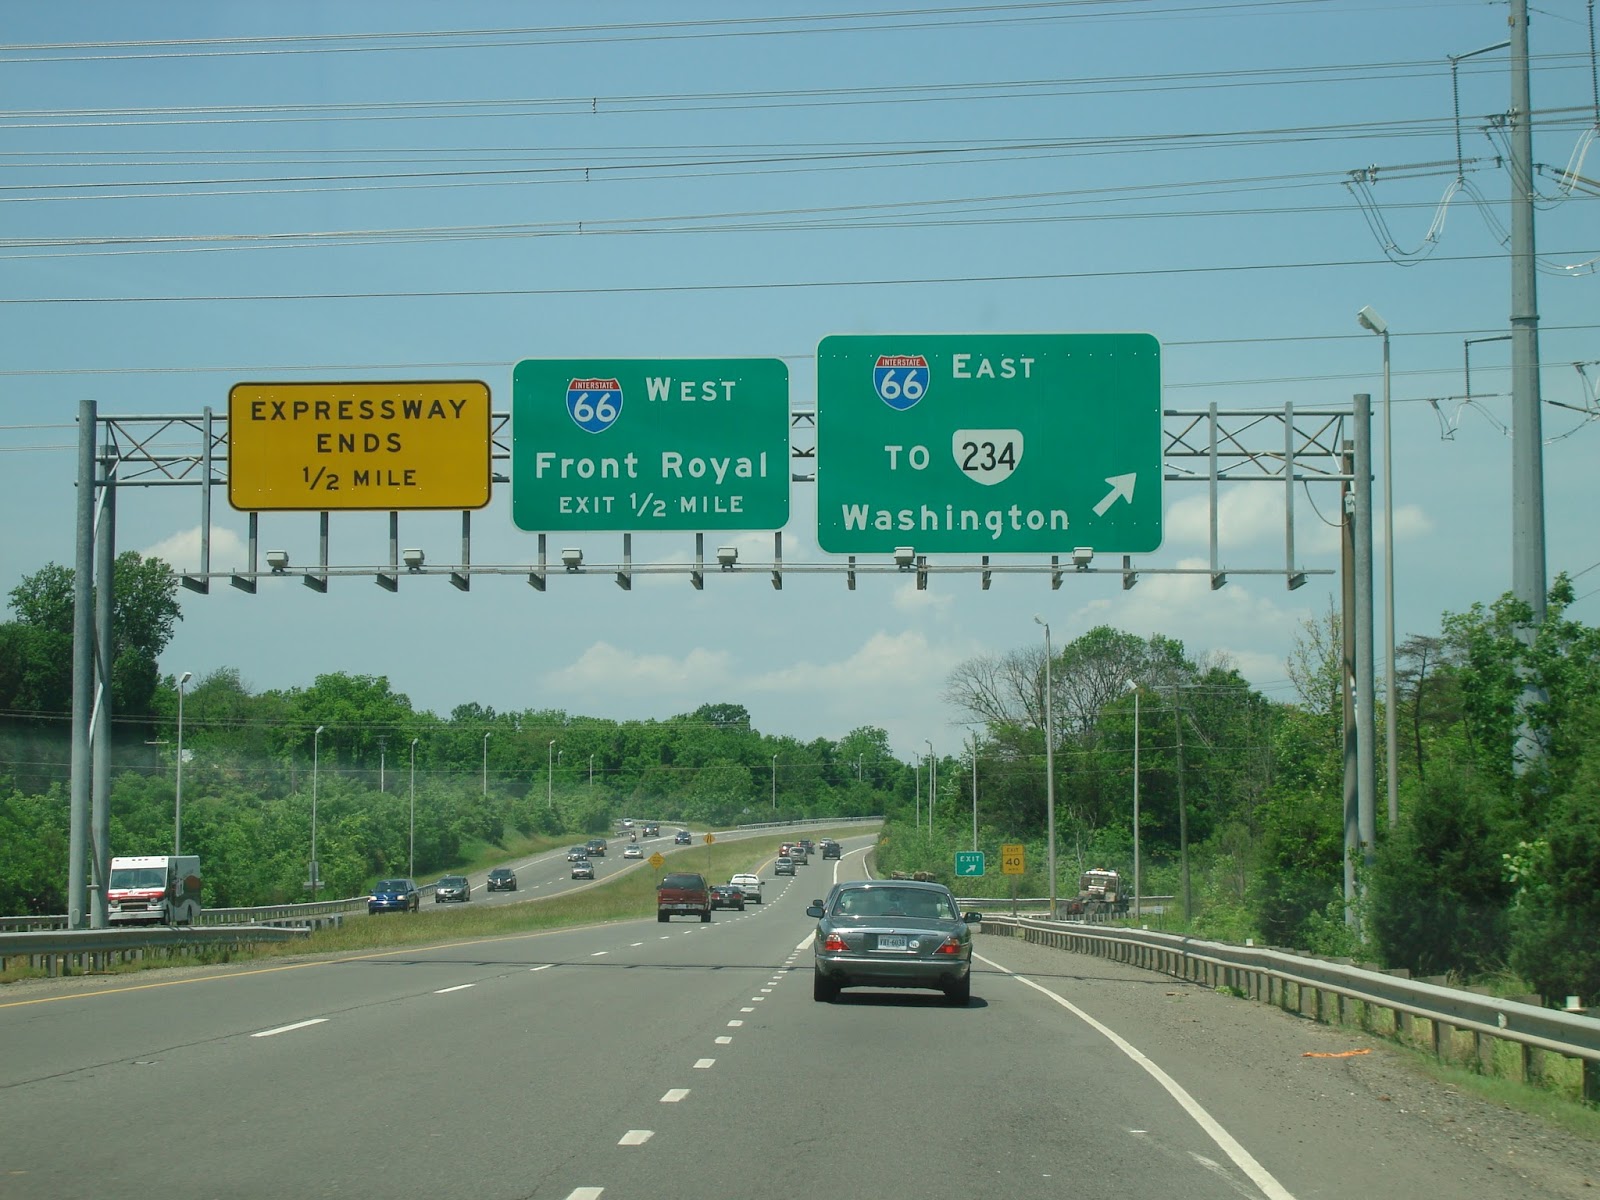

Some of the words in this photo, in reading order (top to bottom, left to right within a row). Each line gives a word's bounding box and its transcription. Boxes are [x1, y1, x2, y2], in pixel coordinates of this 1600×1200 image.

[882, 358, 920, 367] INTERSTATE
[952, 354, 1035, 379] EAST
[575, 382, 614, 390] INTERSTATE
[645, 377, 736, 402] WEST
[880, 370, 923, 400] 66
[251, 400, 467, 421] EXPRESSWAY
[574, 392, 616, 423] 66
[317, 432, 402, 453] ENDS
[536, 452, 638, 479] Front
[661, 451, 767, 485] Royal
[885, 445, 930, 471] TO
[961, 441, 1015, 471] 234
[353, 469, 417, 487] MILE
[559, 496, 615, 514] EXIT
[680, 495, 743, 513] MILE
[842, 504, 1069, 540] Washington
[1005, 857, 1020, 866] 40
